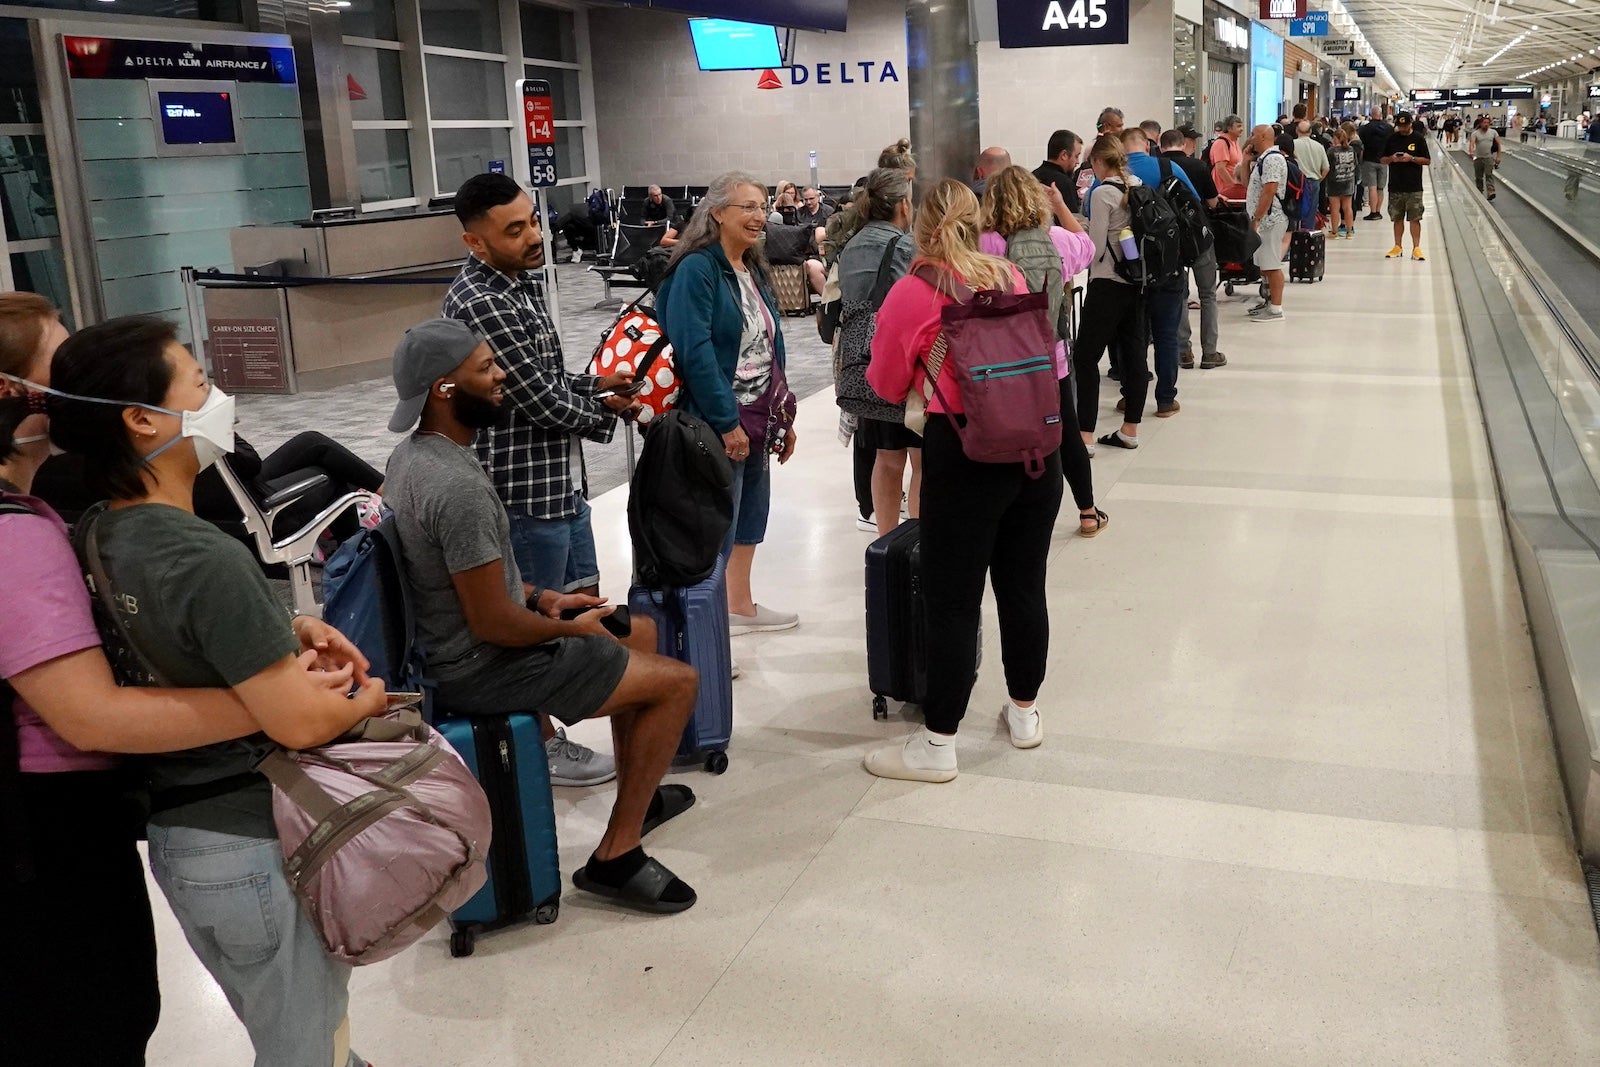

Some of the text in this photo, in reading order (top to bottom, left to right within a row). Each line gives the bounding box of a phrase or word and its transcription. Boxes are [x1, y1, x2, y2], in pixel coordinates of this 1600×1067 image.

[1042, 0, 1108, 31] A45
[1302, 22, 1316, 34] SPA
[136, 56, 260, 69] DELTA KLM AIRFRANCE
[791, 61, 899, 85] DELTA
[183, 109, 195, 117] AM
[529, 120, 550, 139] 1-4
[1408, 143, 1415, 151] G
[533, 165, 555, 183] 5-8
